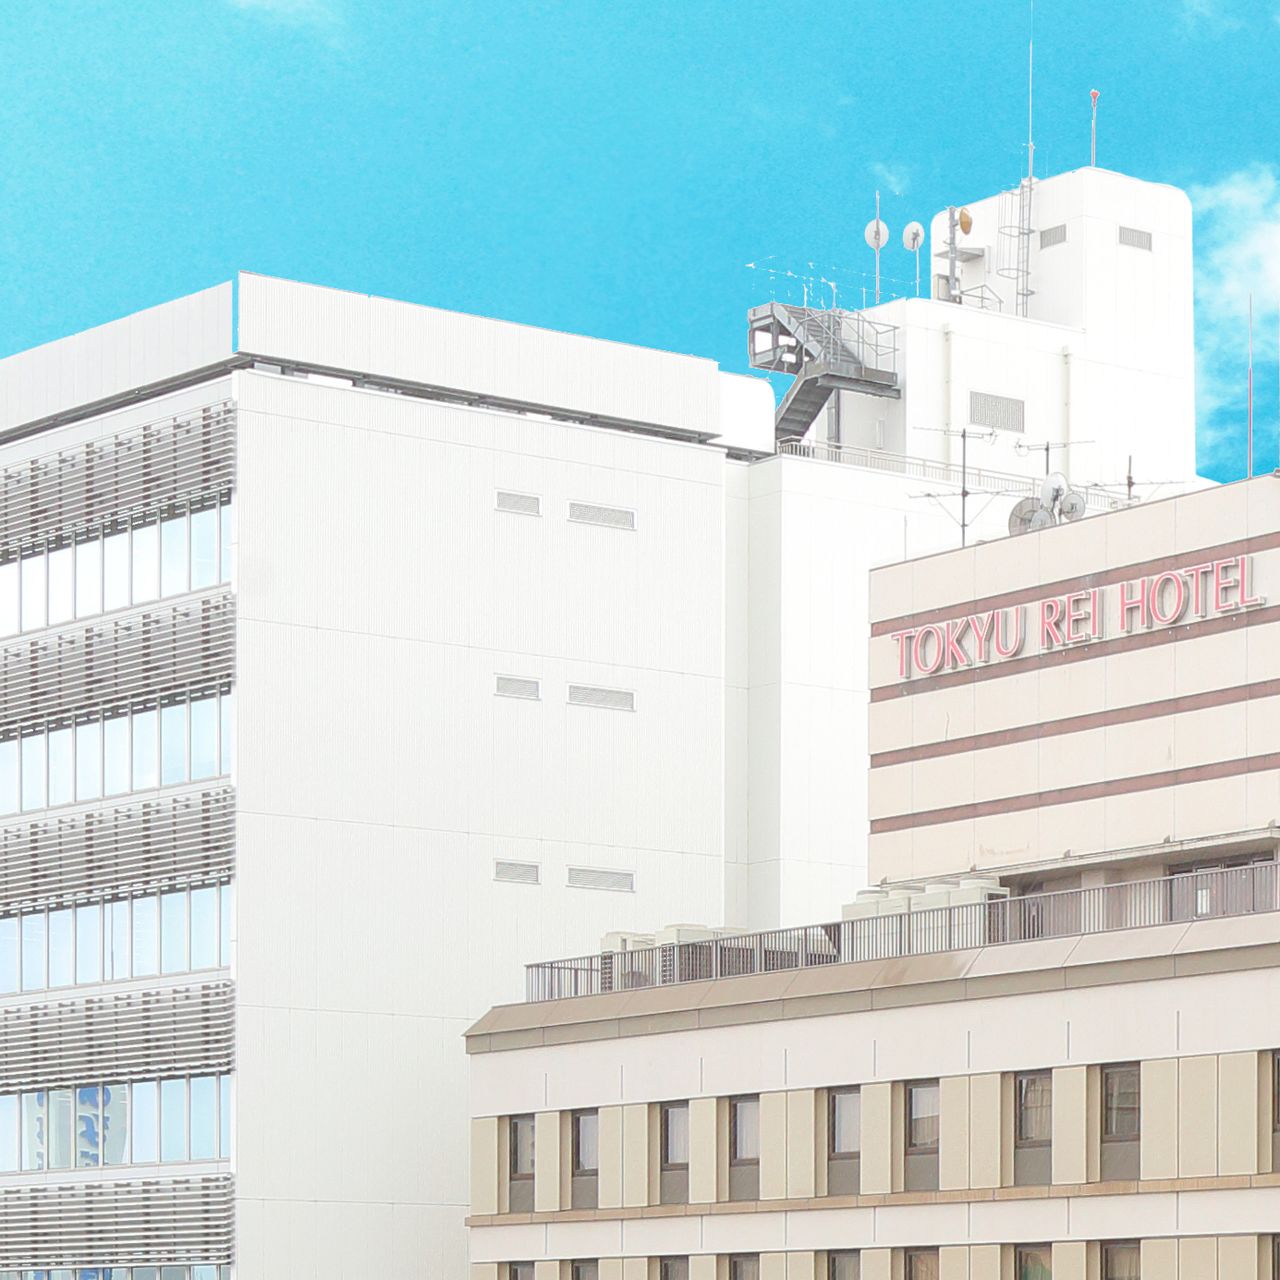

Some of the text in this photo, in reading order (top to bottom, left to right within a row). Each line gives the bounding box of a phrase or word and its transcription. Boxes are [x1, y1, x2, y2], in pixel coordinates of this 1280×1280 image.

[891, 554, 1267, 679] TOKYU REI HOTEL
